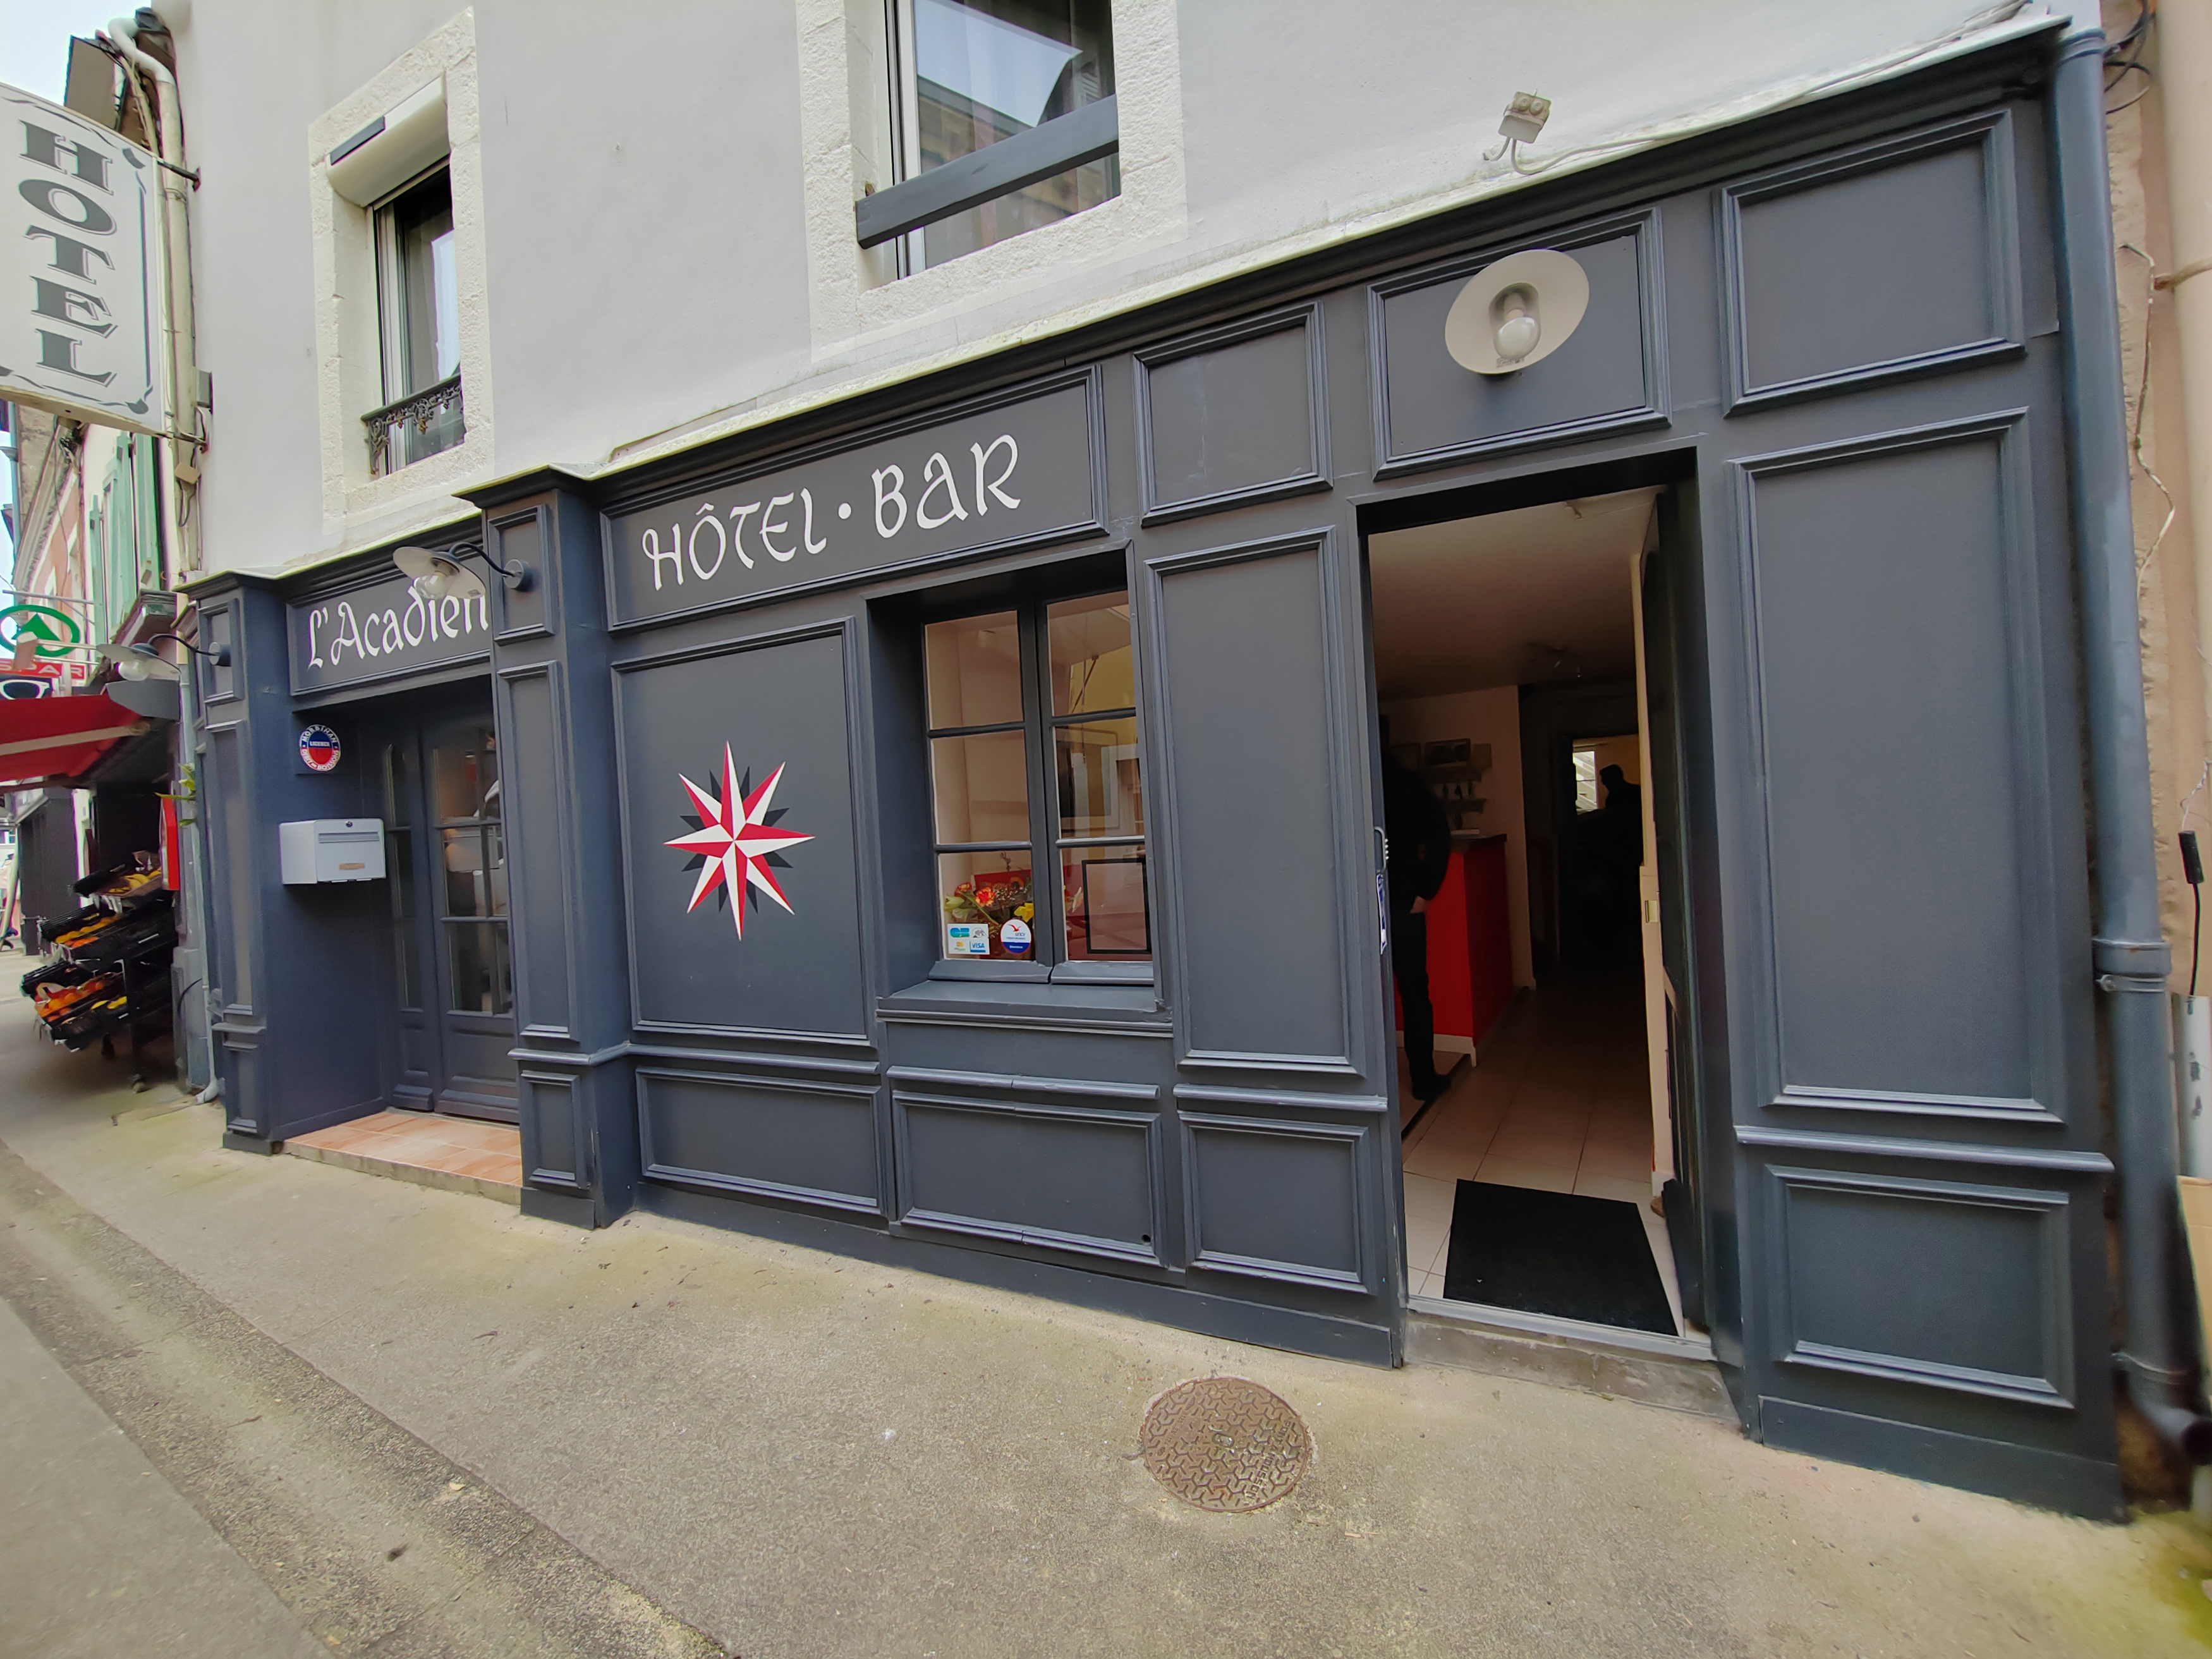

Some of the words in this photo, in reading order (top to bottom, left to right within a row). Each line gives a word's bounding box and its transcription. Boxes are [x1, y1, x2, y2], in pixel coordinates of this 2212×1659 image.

[18, 119, 119, 387] HOTEL
[642, 488, 827, 591] HÔTEL
[872, 434, 1021, 538] BAR
[307, 586, 489, 671] L'Acadien
[301, 726, 337, 743] MORBIHAN
[317, 750, 339, 770] BOISSONS
[1275, 1419, 1291, 1444] PONT
[1246, 1452, 1275, 1499] MOUSSON
